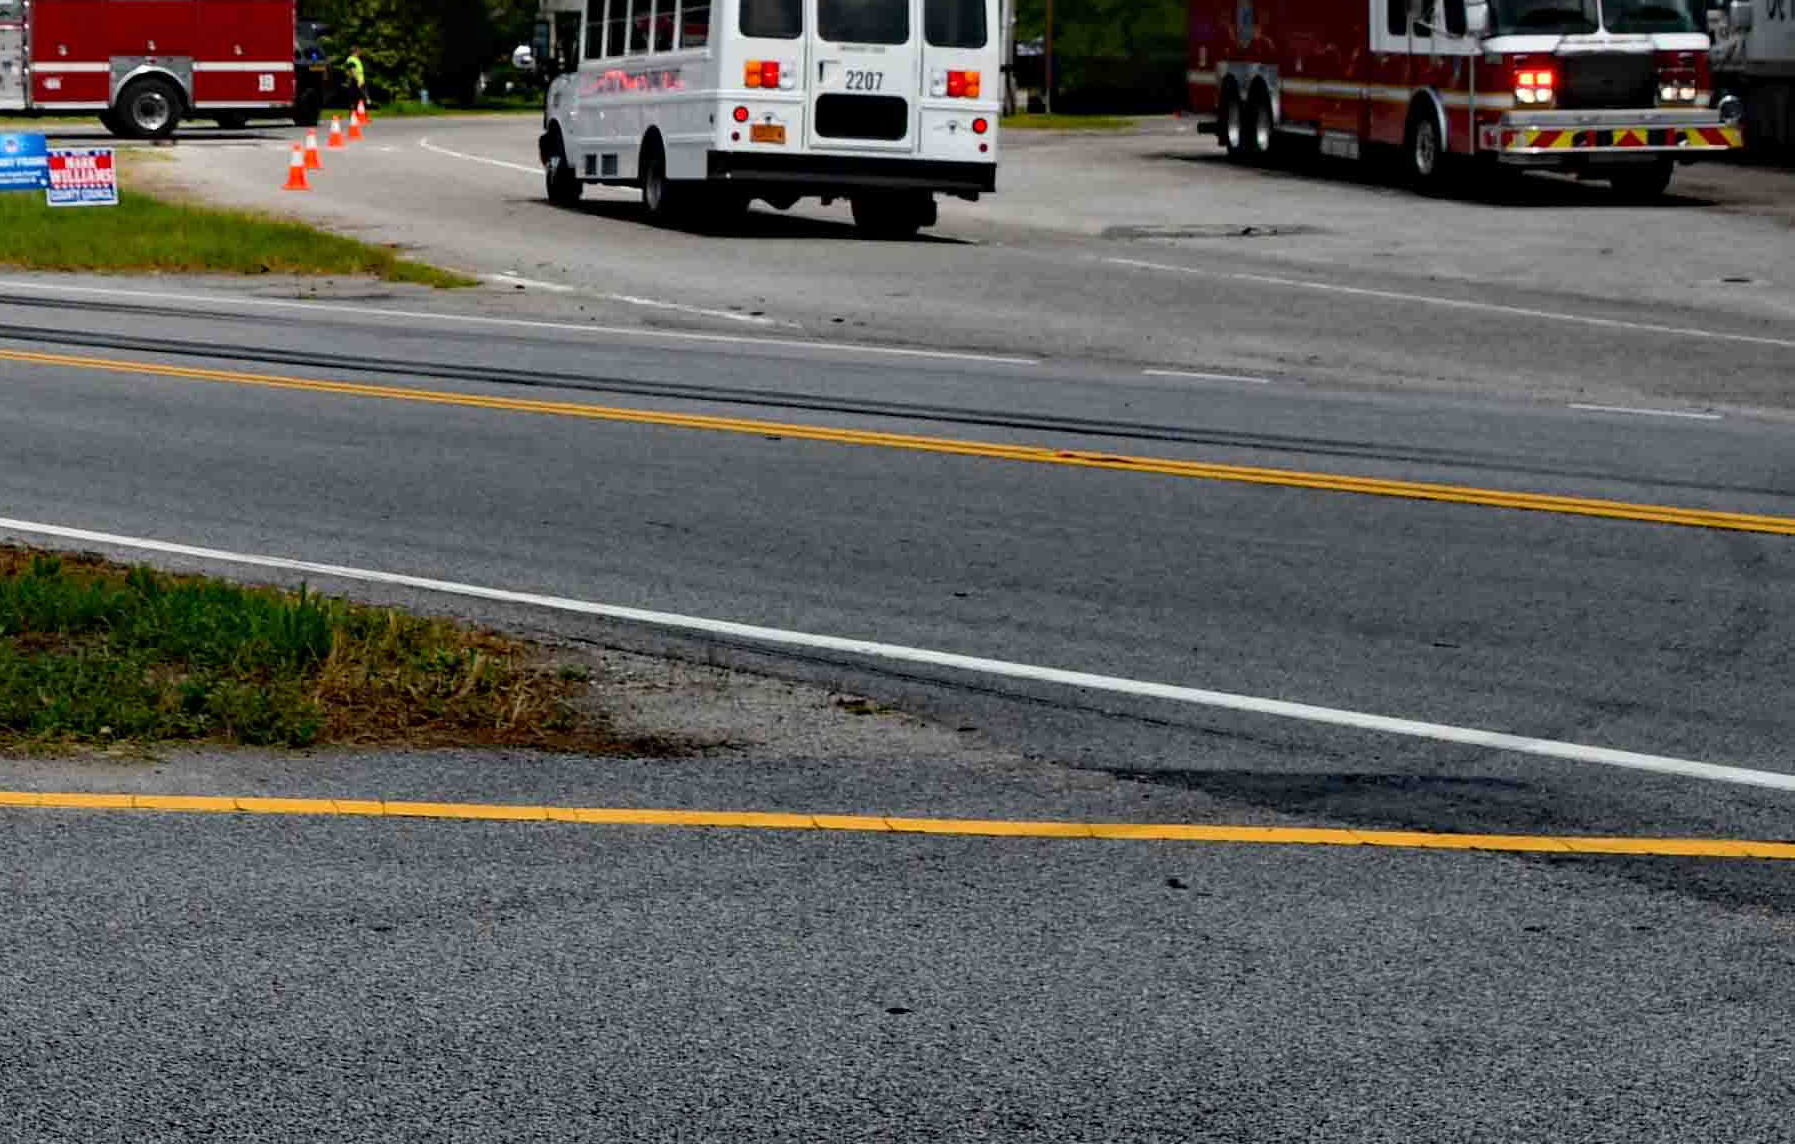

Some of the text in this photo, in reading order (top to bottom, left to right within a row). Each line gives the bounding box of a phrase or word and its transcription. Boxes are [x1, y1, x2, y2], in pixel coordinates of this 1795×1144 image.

[845, 69, 884, 91] 2207
[64, 156, 96, 169] MARK
[48, 168, 113, 184] WILLIAMS
